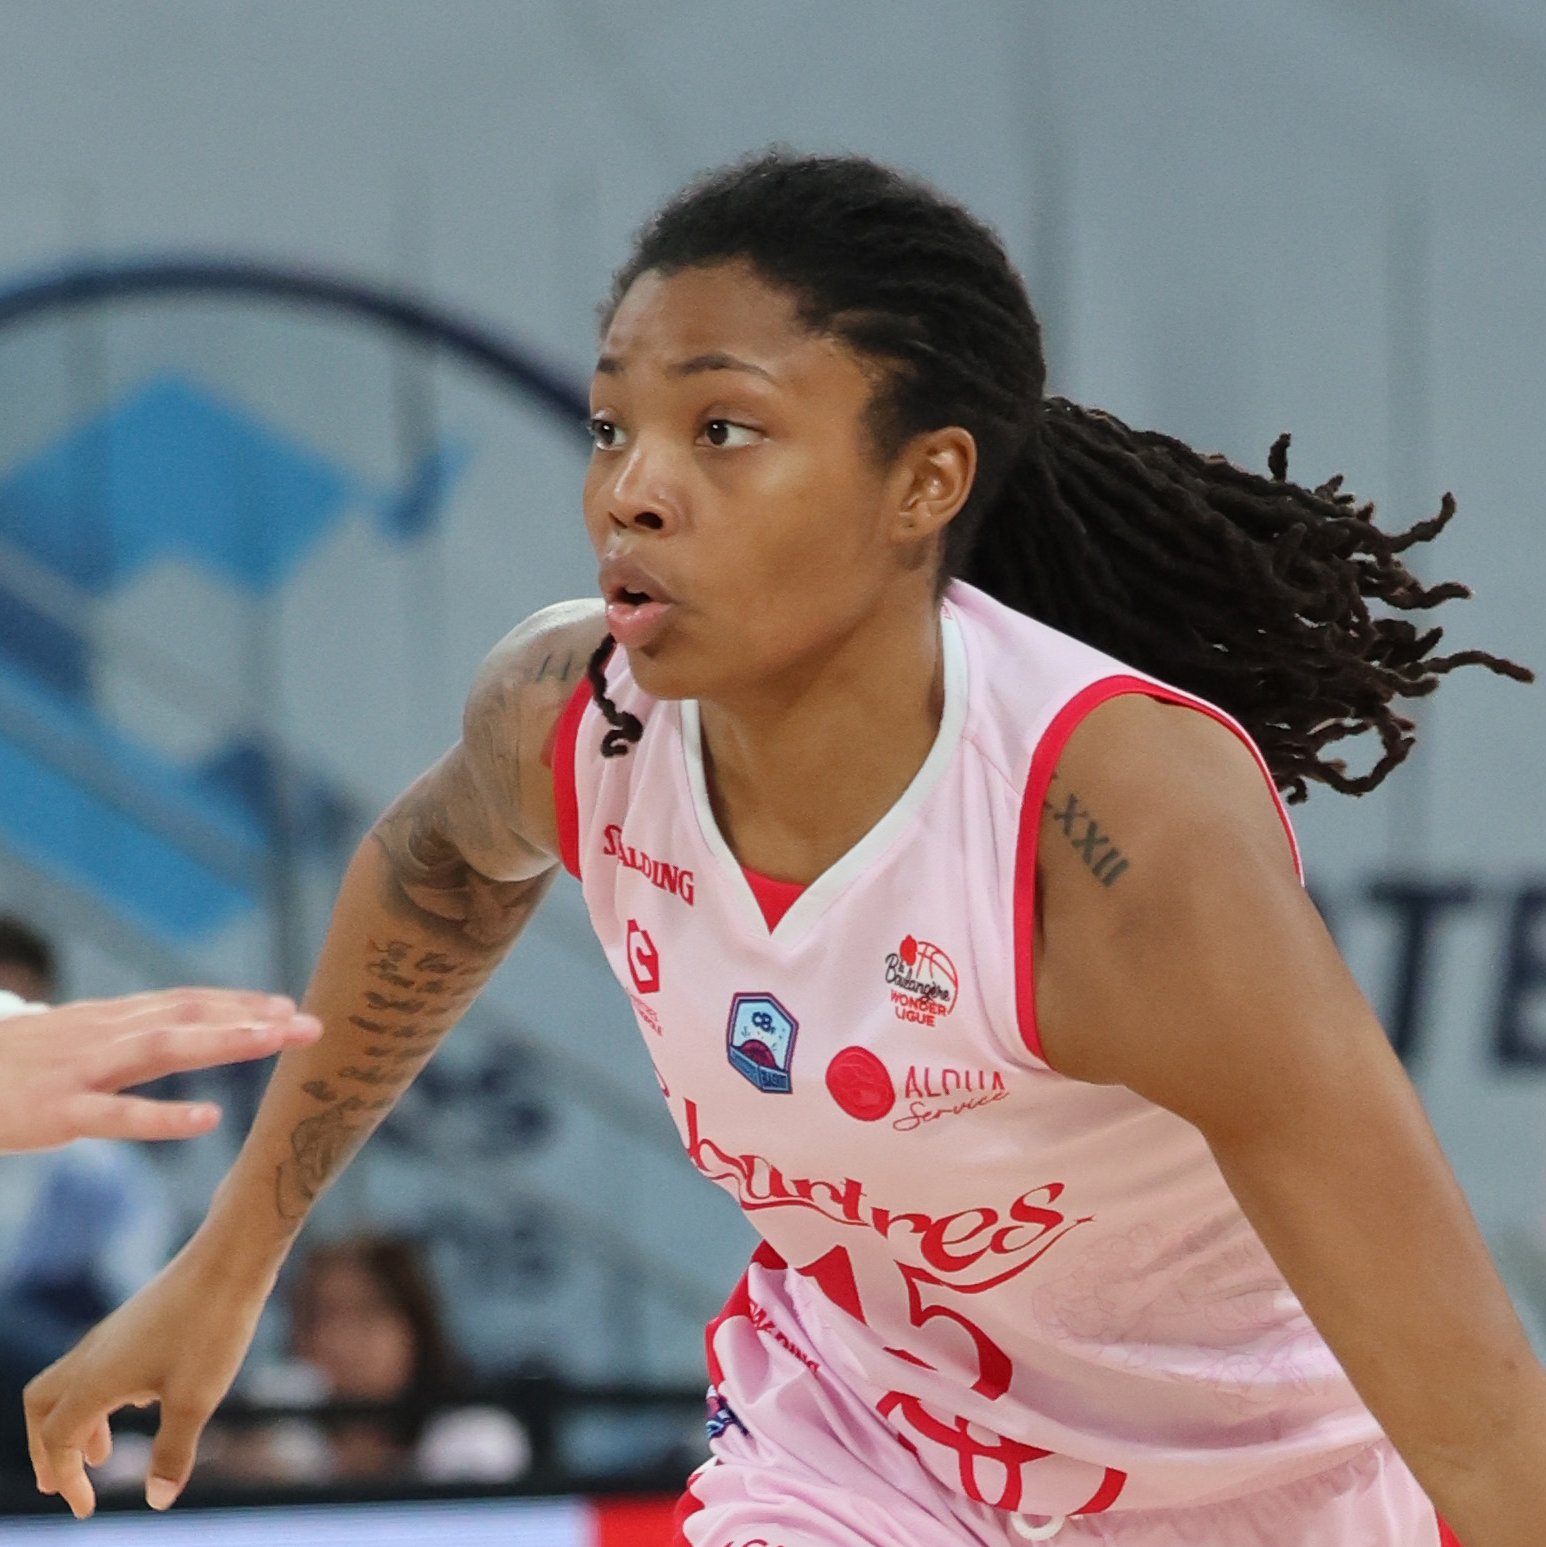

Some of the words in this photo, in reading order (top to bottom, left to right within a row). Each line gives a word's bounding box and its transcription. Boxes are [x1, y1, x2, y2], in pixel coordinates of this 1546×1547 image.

[602, 823, 695, 907] SALDING
[890, 988, 947, 1017] WONDER
[895, 1005, 936, 1028] LIGUE
